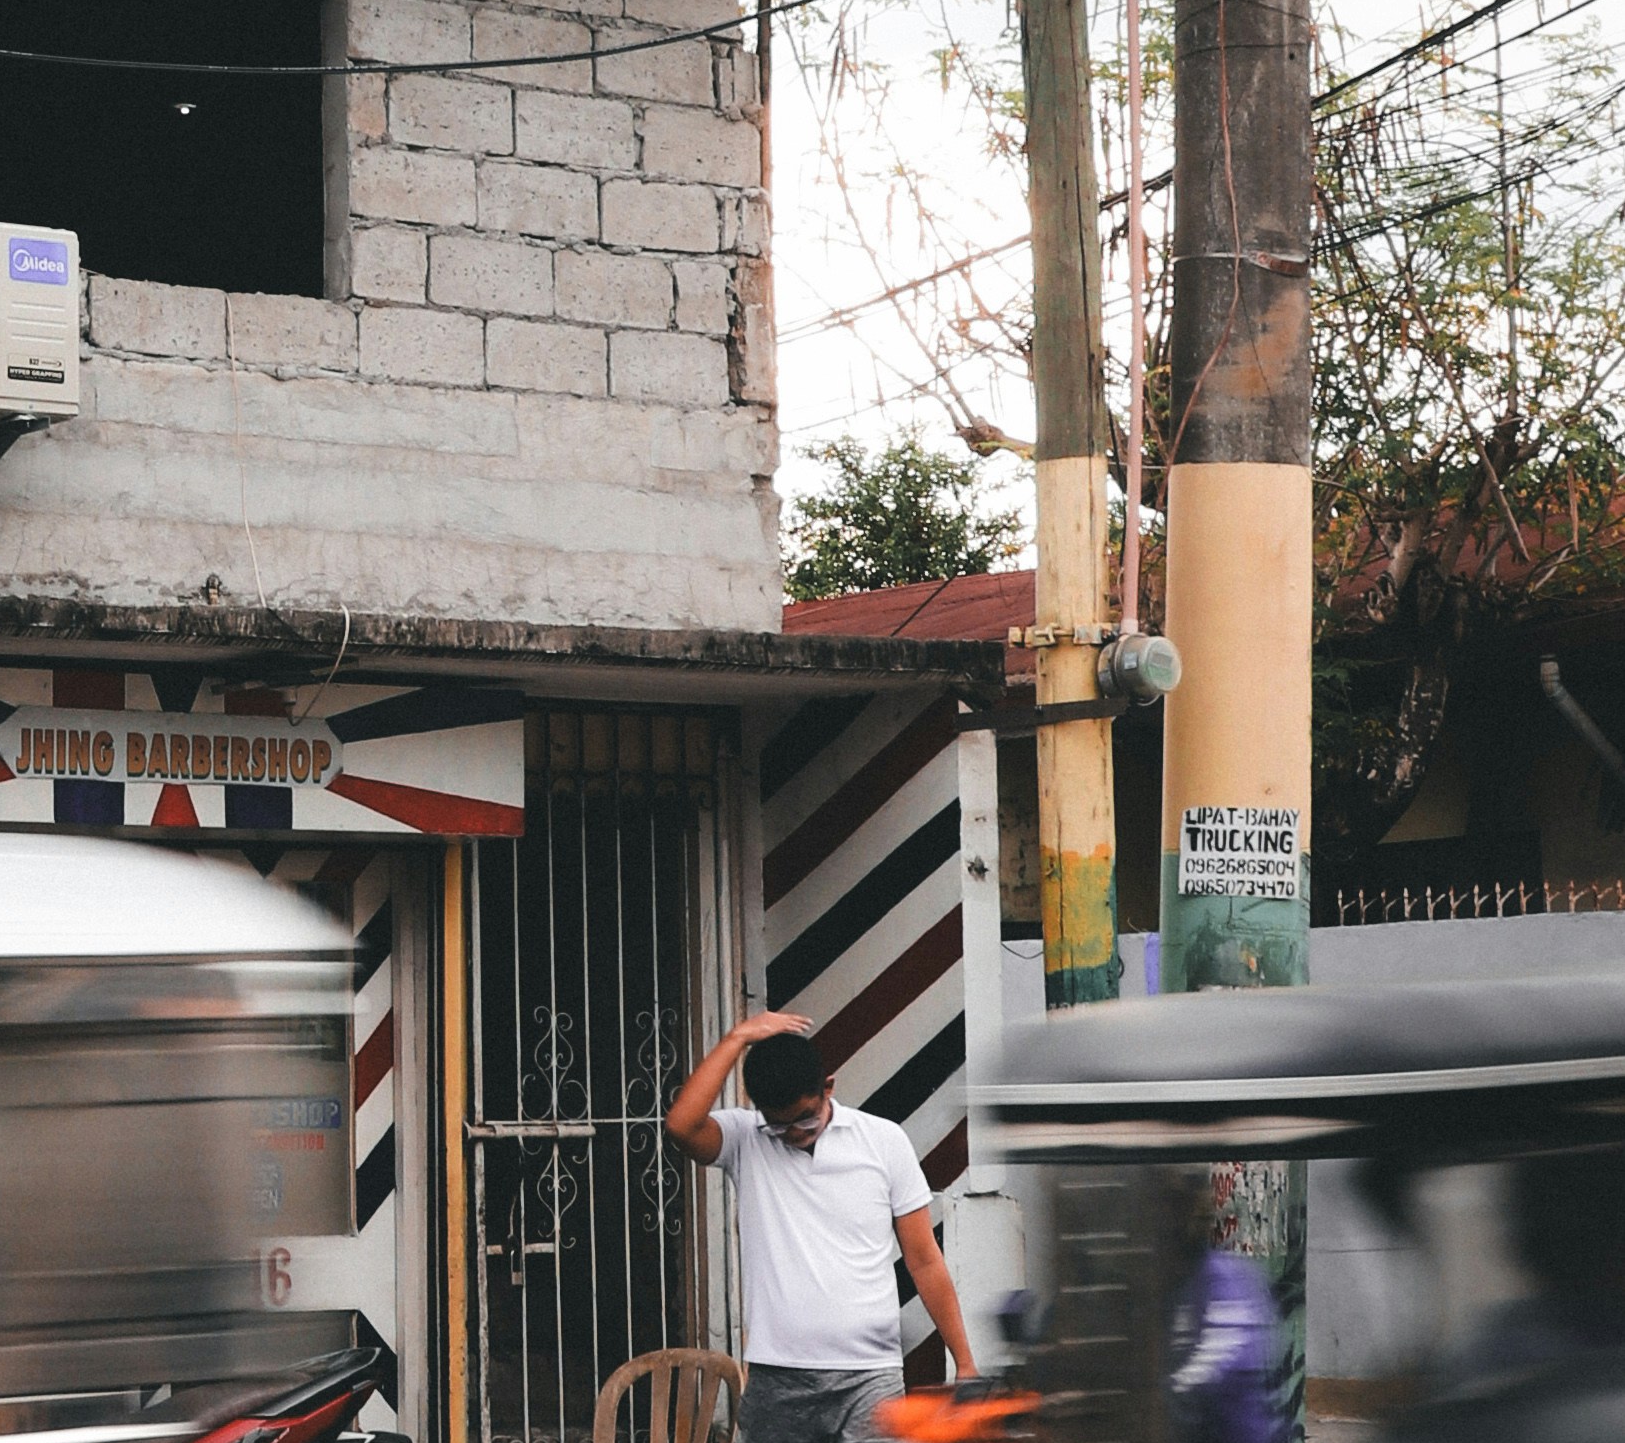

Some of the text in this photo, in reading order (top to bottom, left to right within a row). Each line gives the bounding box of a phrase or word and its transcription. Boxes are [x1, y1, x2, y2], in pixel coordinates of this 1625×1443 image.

[13, 249, 64, 273] Midea
[16, 728, 332, 784] JHING BARBERSHOP
[1186, 807, 1300, 827] LIPAT-BAHAY
[1186, 827, 1293, 854] TRUCKING
[1185, 858, 1295, 876] 09626865004
